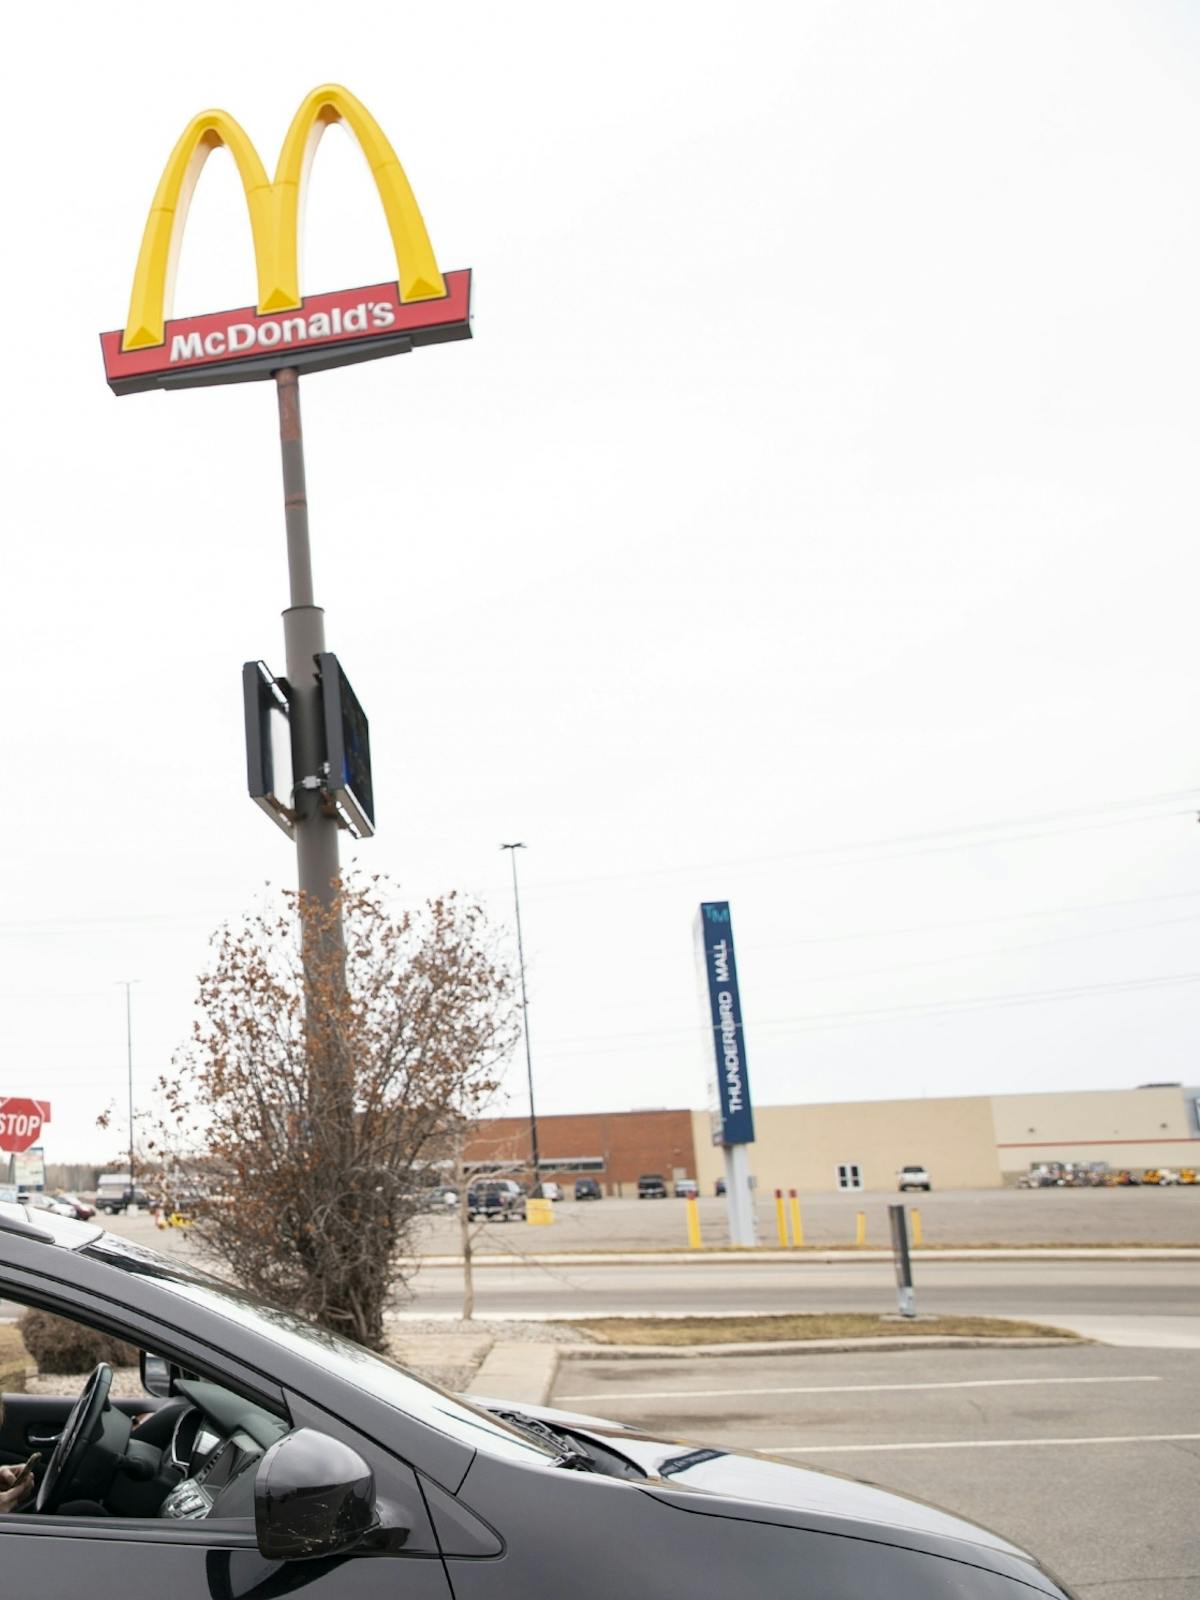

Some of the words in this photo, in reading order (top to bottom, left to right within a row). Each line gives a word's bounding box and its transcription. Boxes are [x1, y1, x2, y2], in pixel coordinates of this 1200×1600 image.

[170, 302, 395, 362] McDonald's
[703, 904, 729, 923] TM
[713, 939, 730, 982] MALL
[718, 991, 742, 1114] THUNDERBIRD
